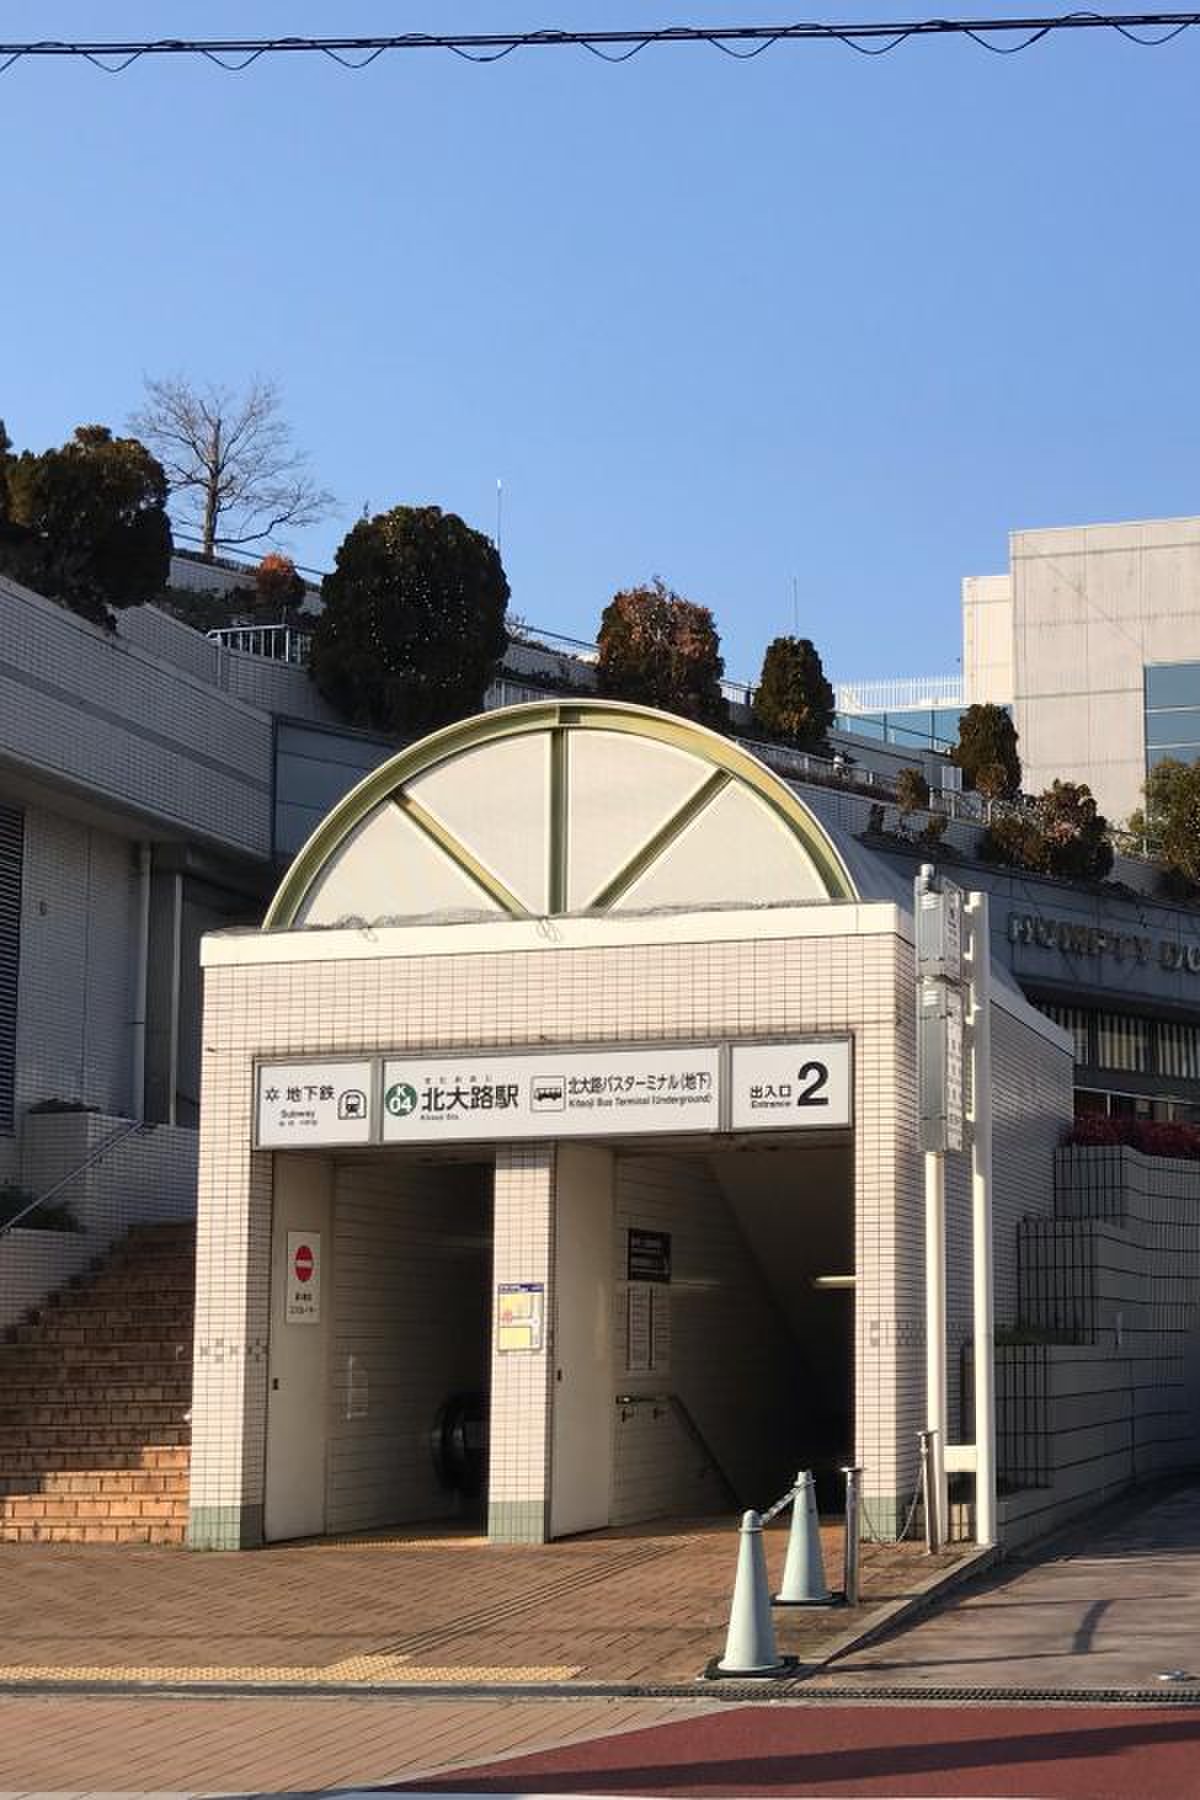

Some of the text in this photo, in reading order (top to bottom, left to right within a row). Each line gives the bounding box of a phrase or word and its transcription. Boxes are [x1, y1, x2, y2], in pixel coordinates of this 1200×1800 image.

[286, 1085, 336, 1103] 地下鉄
[750, 1085, 792, 1099] 出入口
[797, 1060, 830, 1107] 2
[421, 1084, 520, 1112] 北大路駅
